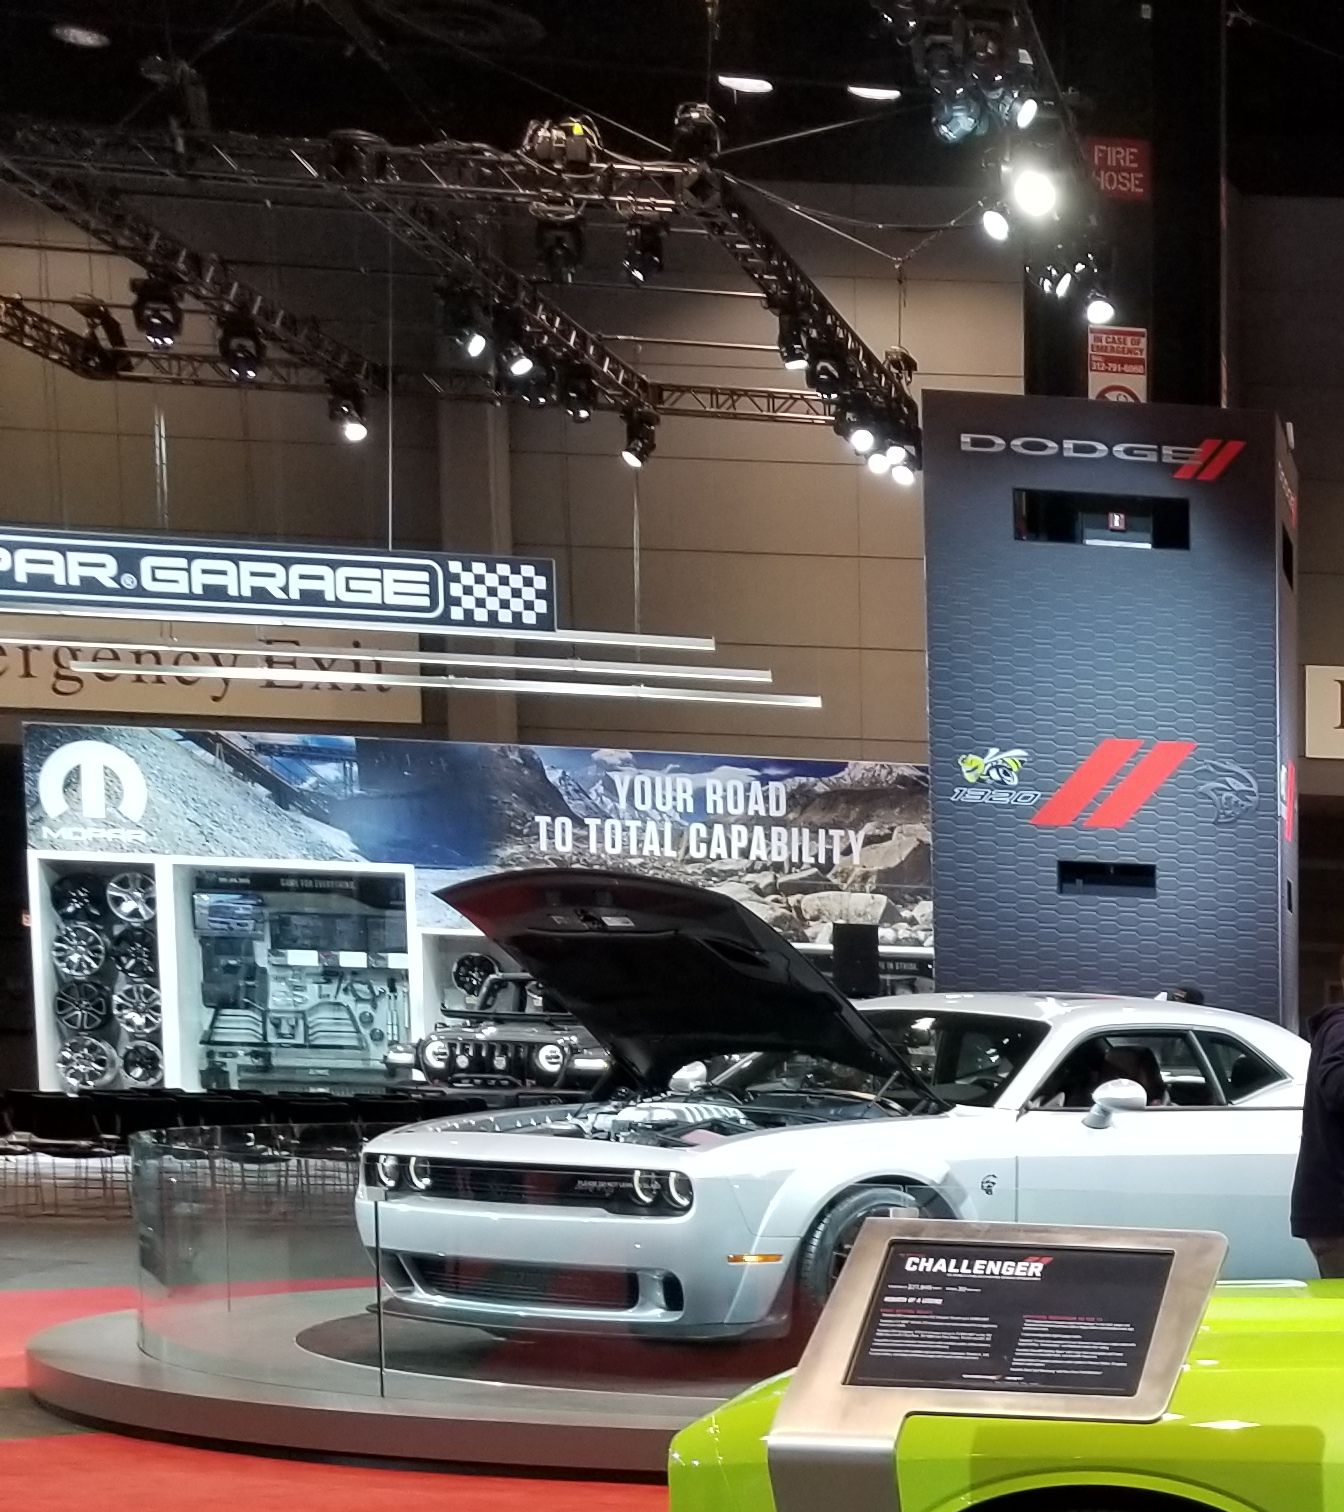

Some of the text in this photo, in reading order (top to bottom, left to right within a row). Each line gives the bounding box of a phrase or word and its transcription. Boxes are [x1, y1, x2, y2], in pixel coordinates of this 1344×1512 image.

[1094, 145, 1138, 167] FIRE
[1091, 343, 1144, 357] EMERGENCY
[1105, 336, 1127, 346] CASE
[1130, 338, 1141, 347] OF
[960, 433, 1204, 465] DODGE
[612, 773, 787, 817] YOUR ROAD
[949, 787, 1041, 806] 1320
[42, 825, 147, 843] MOPAR
[535, 815, 866, 866] TO TOTAL CAPABILITY
[904, 1256, 1044, 1278] CHALLENGER
